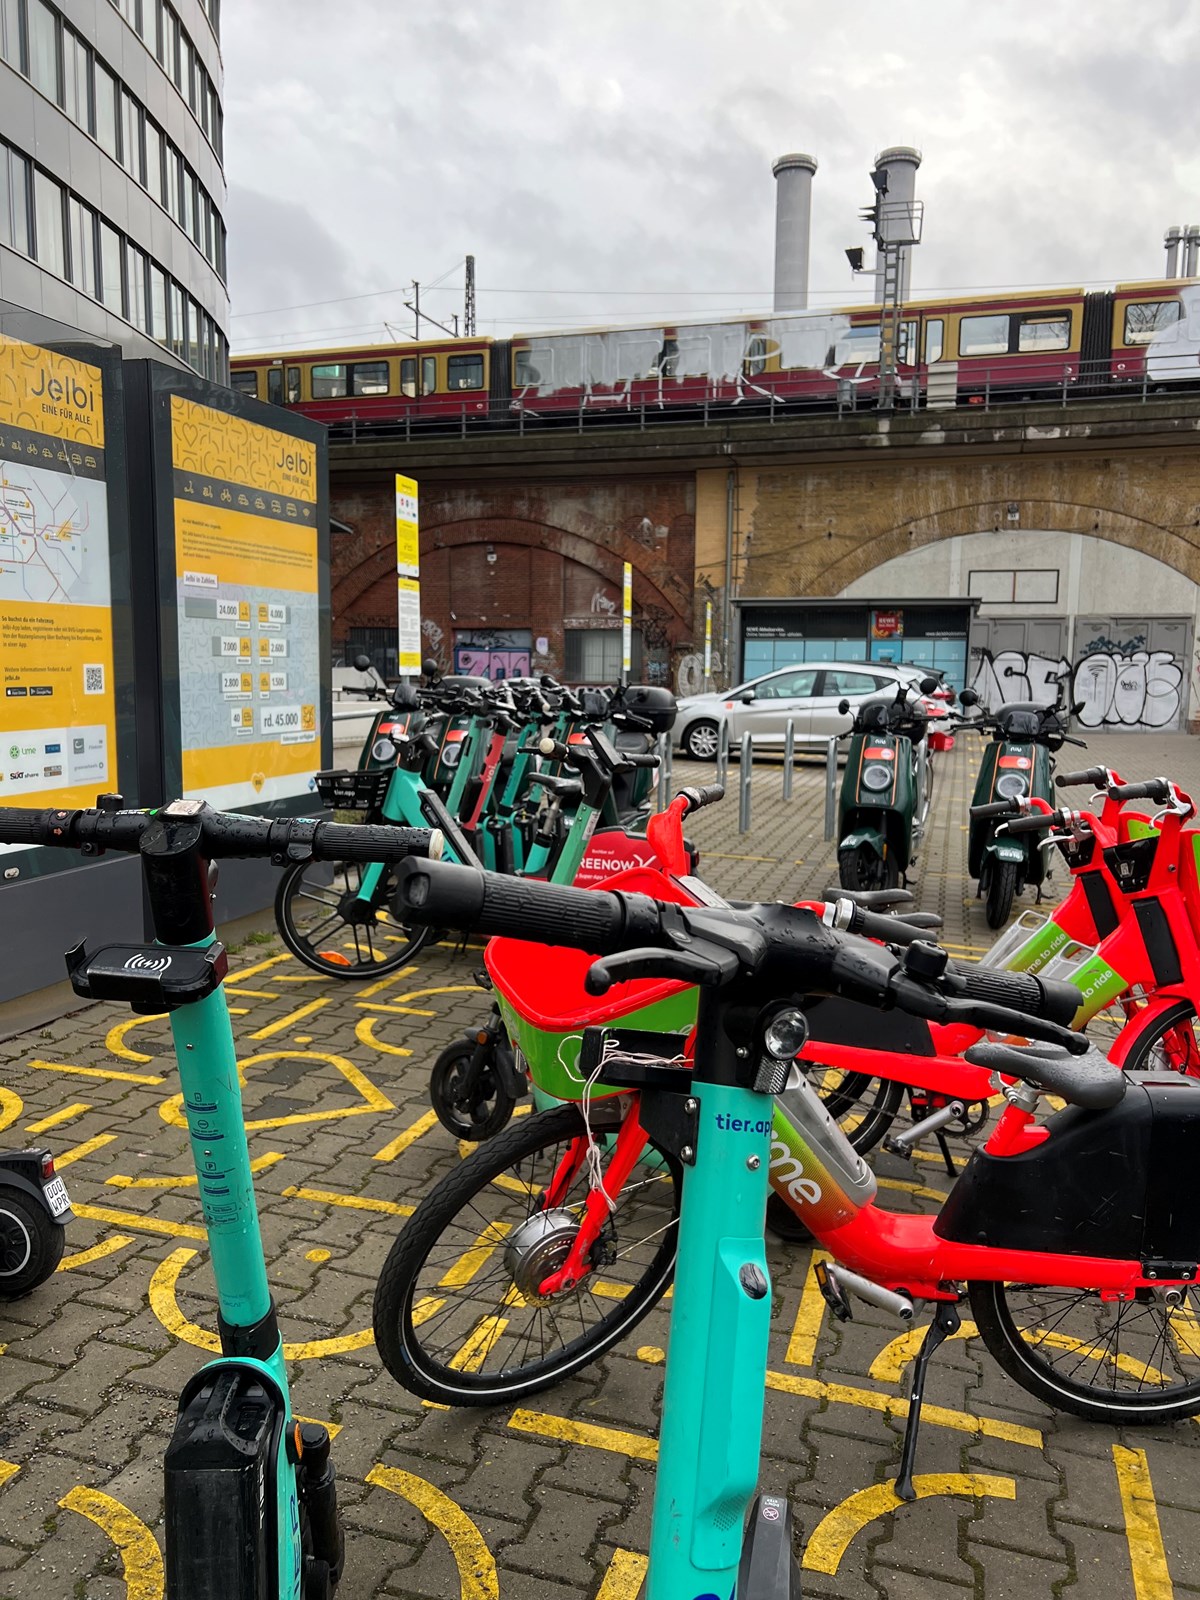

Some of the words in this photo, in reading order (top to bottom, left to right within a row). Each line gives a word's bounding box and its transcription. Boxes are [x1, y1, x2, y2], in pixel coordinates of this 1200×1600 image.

[31, 368, 94, 412] Jelbi
[41, 403, 58, 416] EINE
[59, 407, 73, 420] FÜR
[75, 412, 93, 426] ALLE.
[276, 447, 312, 478] Jelbi
[219, 605, 237, 616] 24.000
[270, 609, 284, 619] 4.000
[223, 641, 238, 652] 7.000
[224, 678, 239, 688] 2.800
[233, 713, 241, 723] 40
[263, 713, 274, 728] rd.
[275, 712, 299, 727] 45.000
[580, 857, 635, 872] REENOW
[1040, 949, 1051, 960] to
[1050, 932, 1067, 951] ride
[1081, 987, 1094, 999] to
[1094, 968, 1114, 989] ride
[715, 1113, 773, 1138] tier.ap
